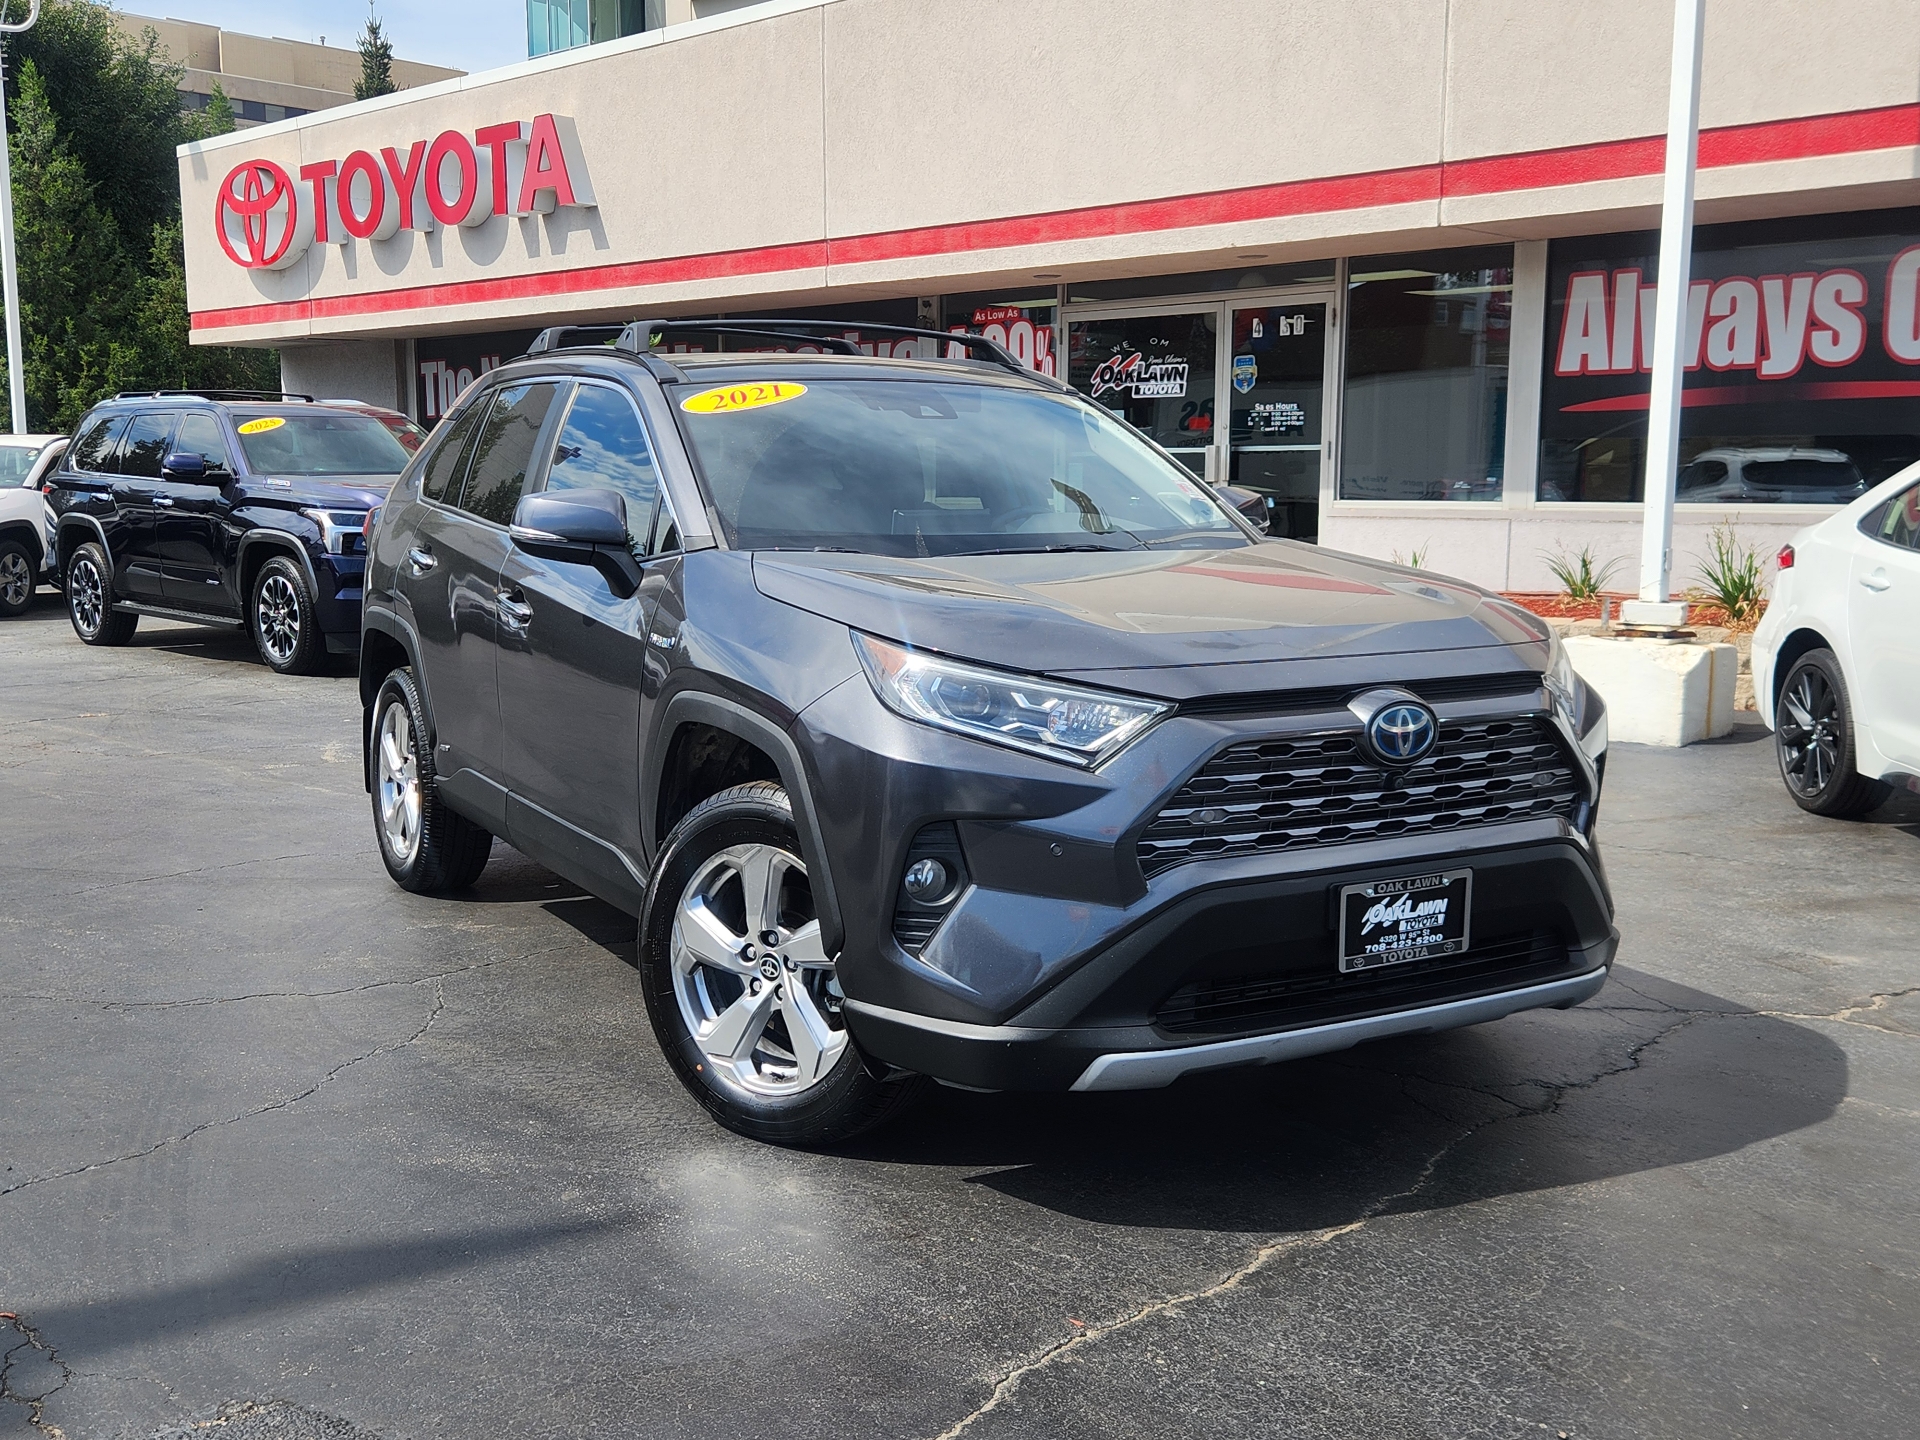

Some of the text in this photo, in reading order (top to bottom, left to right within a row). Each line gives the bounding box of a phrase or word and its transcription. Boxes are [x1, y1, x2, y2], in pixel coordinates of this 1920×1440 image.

[300, 113, 578, 243] TOYOTA
[975, 308, 1018, 321] As Low As
[1138, 383, 1182, 395] TOYOTA
[710, 384, 784, 410] 2021
[1254, 402, 1298, 411] Saes Hours
[247, 418, 277, 432] 2025
[1378, 877, 1440, 893] OAK LAWN
[1405, 915, 1439, 930] TOYOTA
[1365, 933, 1444, 954] 708-423-5200
[1379, 935, 1397, 943] 4320
[1381, 947, 1428, 963] TOYOTA
